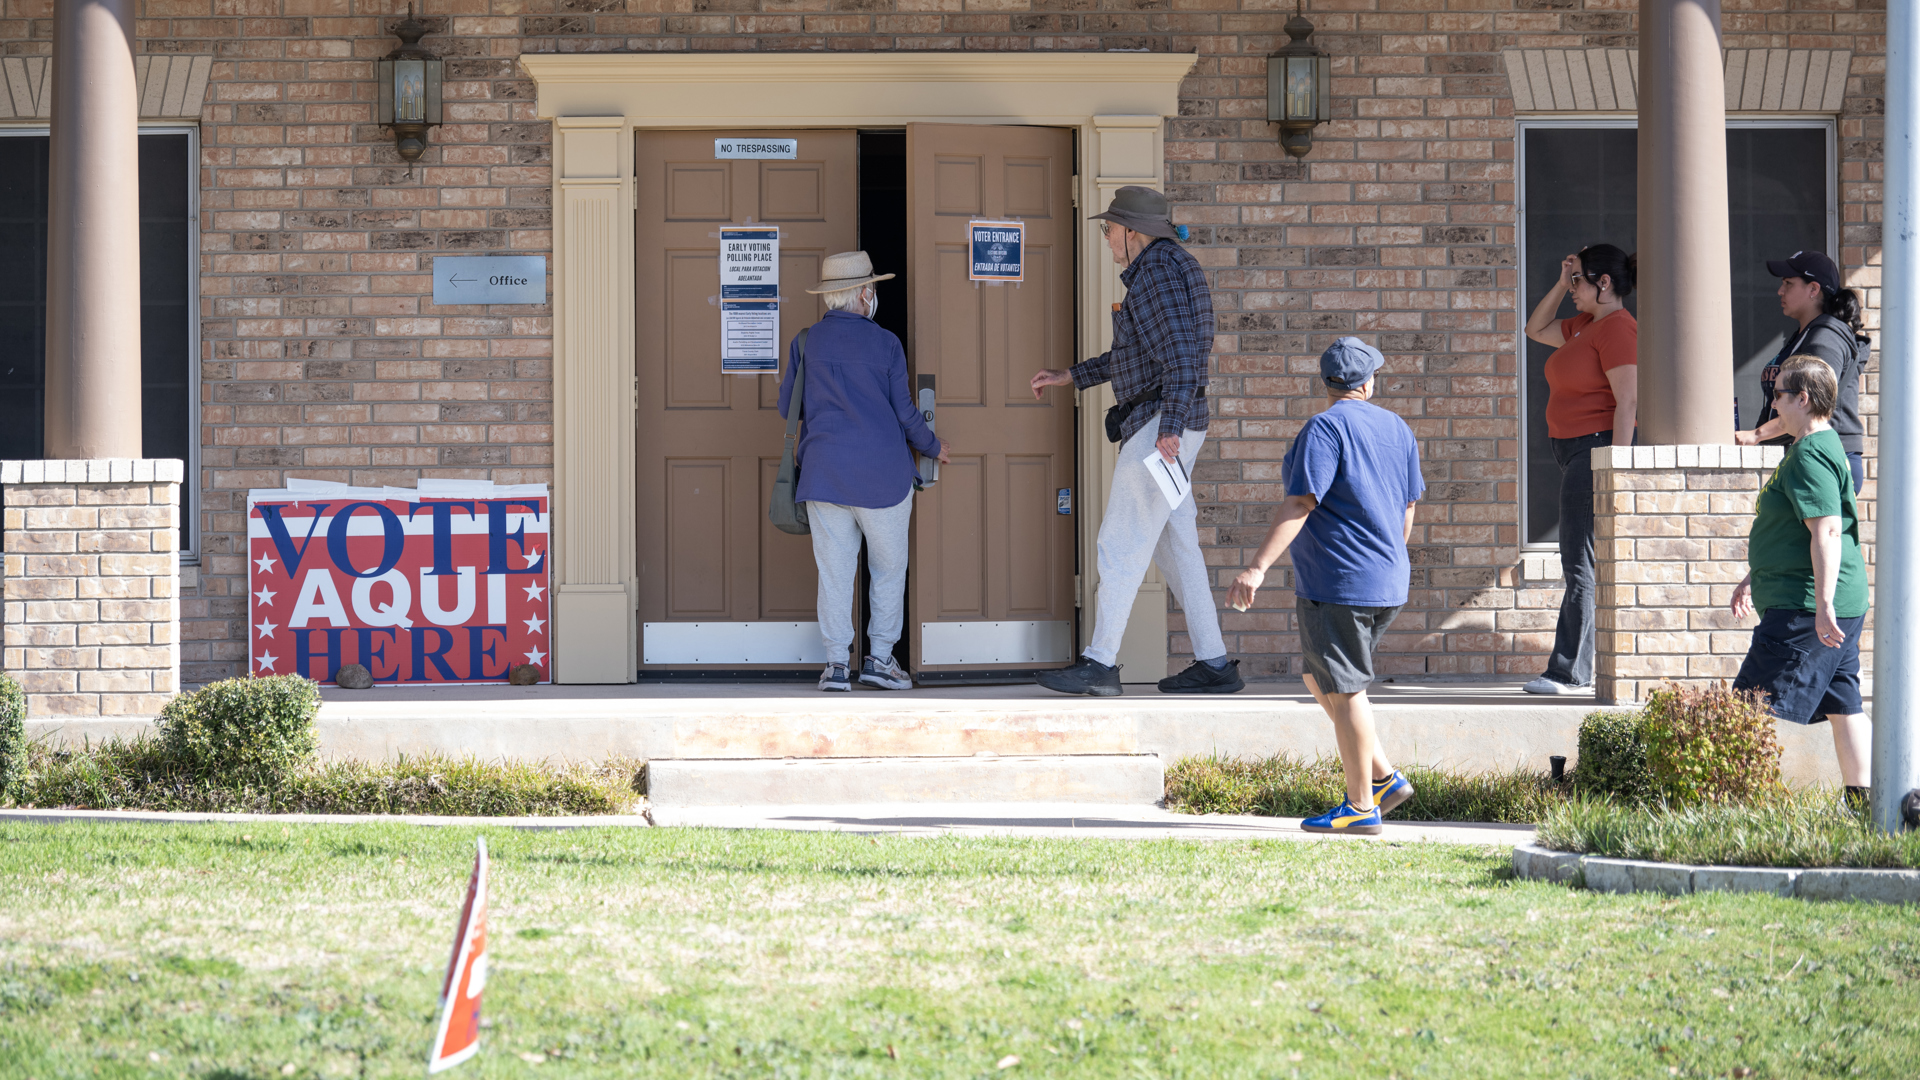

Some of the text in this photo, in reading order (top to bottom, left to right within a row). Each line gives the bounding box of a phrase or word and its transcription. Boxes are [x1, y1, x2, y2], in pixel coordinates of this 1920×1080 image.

[721, 144, 791, 153] NO TRESPASSING
[974, 231, 1019, 243] VOTER ENTRANCE
[728, 243, 770, 251] EARLY VOTING
[727, 253, 772, 261] POLLING PLACE
[975, 263, 1020, 272] ENTRADA DE VOTANTES
[490, 276, 527, 285] Office
[254, 500, 546, 580] VOTE
[288, 566, 507, 631] AQUI
[289, 626, 512, 682] HERE
